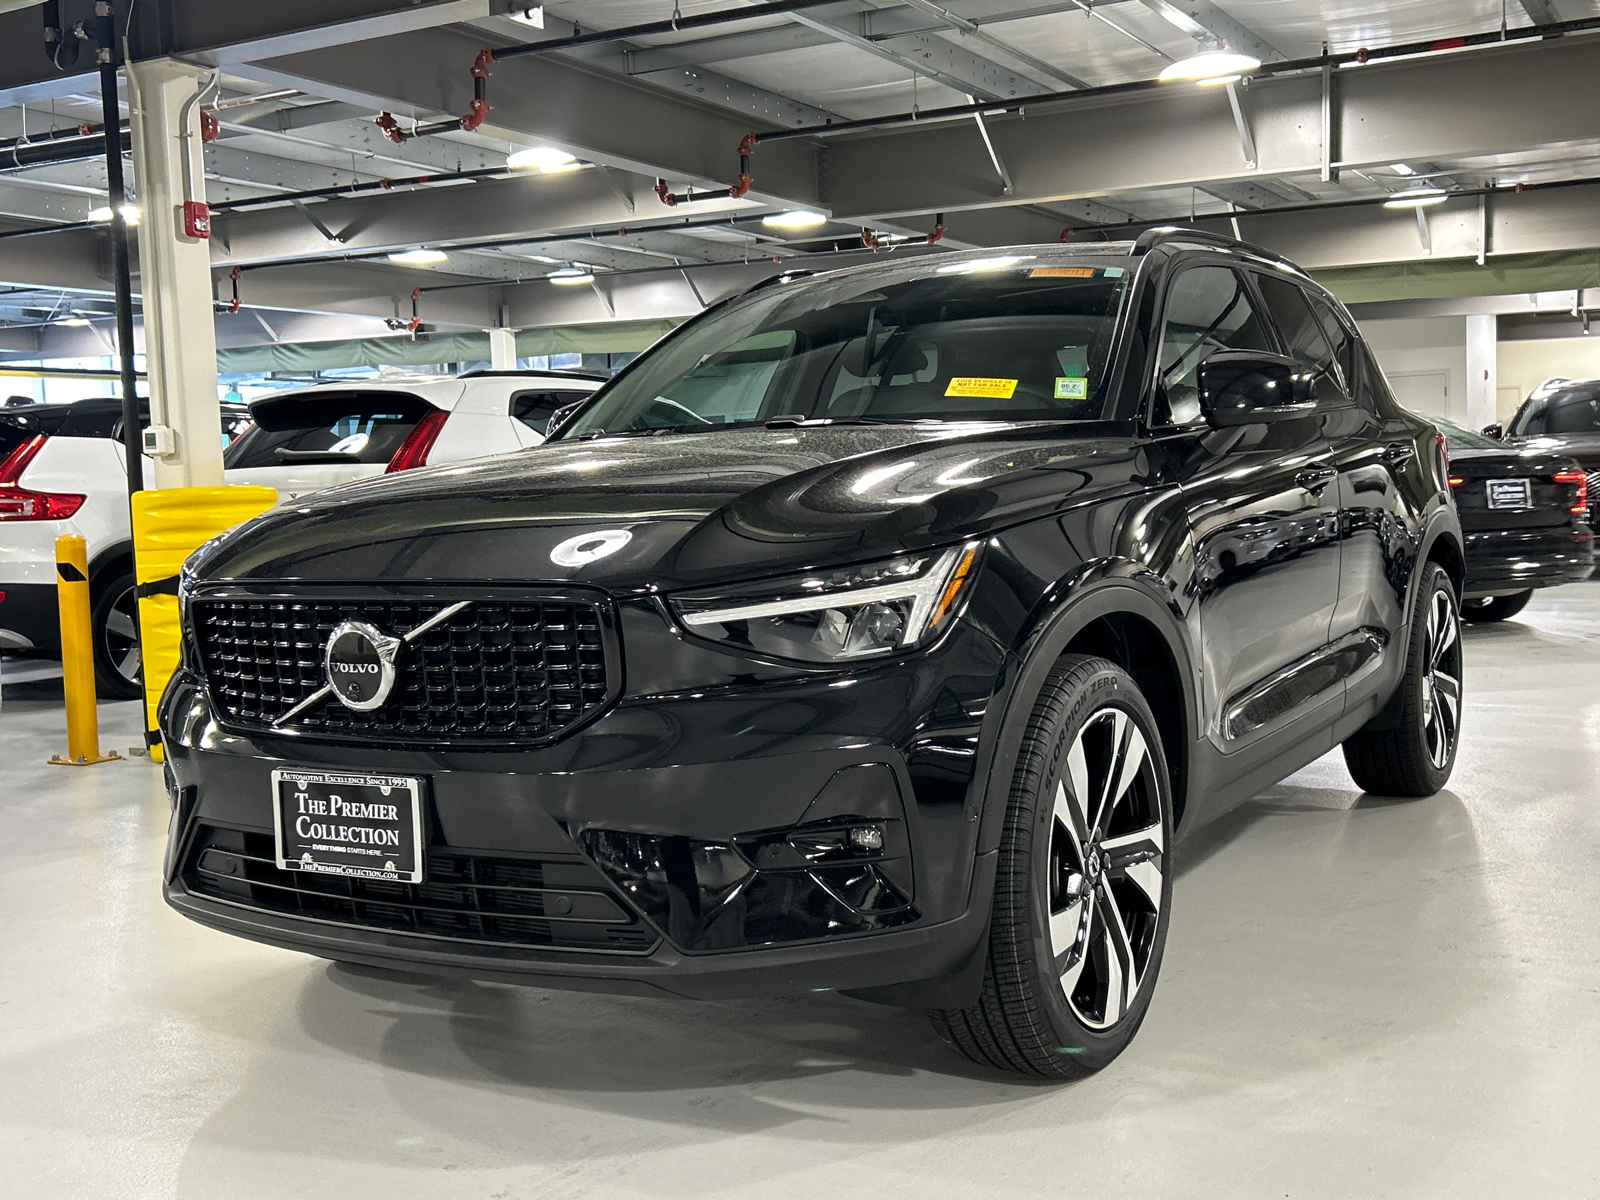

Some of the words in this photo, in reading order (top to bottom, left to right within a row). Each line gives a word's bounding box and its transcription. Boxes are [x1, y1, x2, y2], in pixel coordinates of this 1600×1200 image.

[330, 662, 379, 674] VOLVO
[1045, 692, 1087, 792] SCORPION
[1090, 676, 1118, 695] ZERO
[282, 772, 323, 782] AUTOMOTIVE
[324, 775, 365, 785] EXCELLENCE
[365, 777, 385, 786] SINCE
[388, 778, 407, 787] 1995
[294, 792, 328, 815] THE
[329, 795, 399, 821] PREMIER
[295, 816, 400, 846] COLLECTION
[312, 844, 346, 853] EVERYTHING
[346, 847, 366, 855] STARTS
